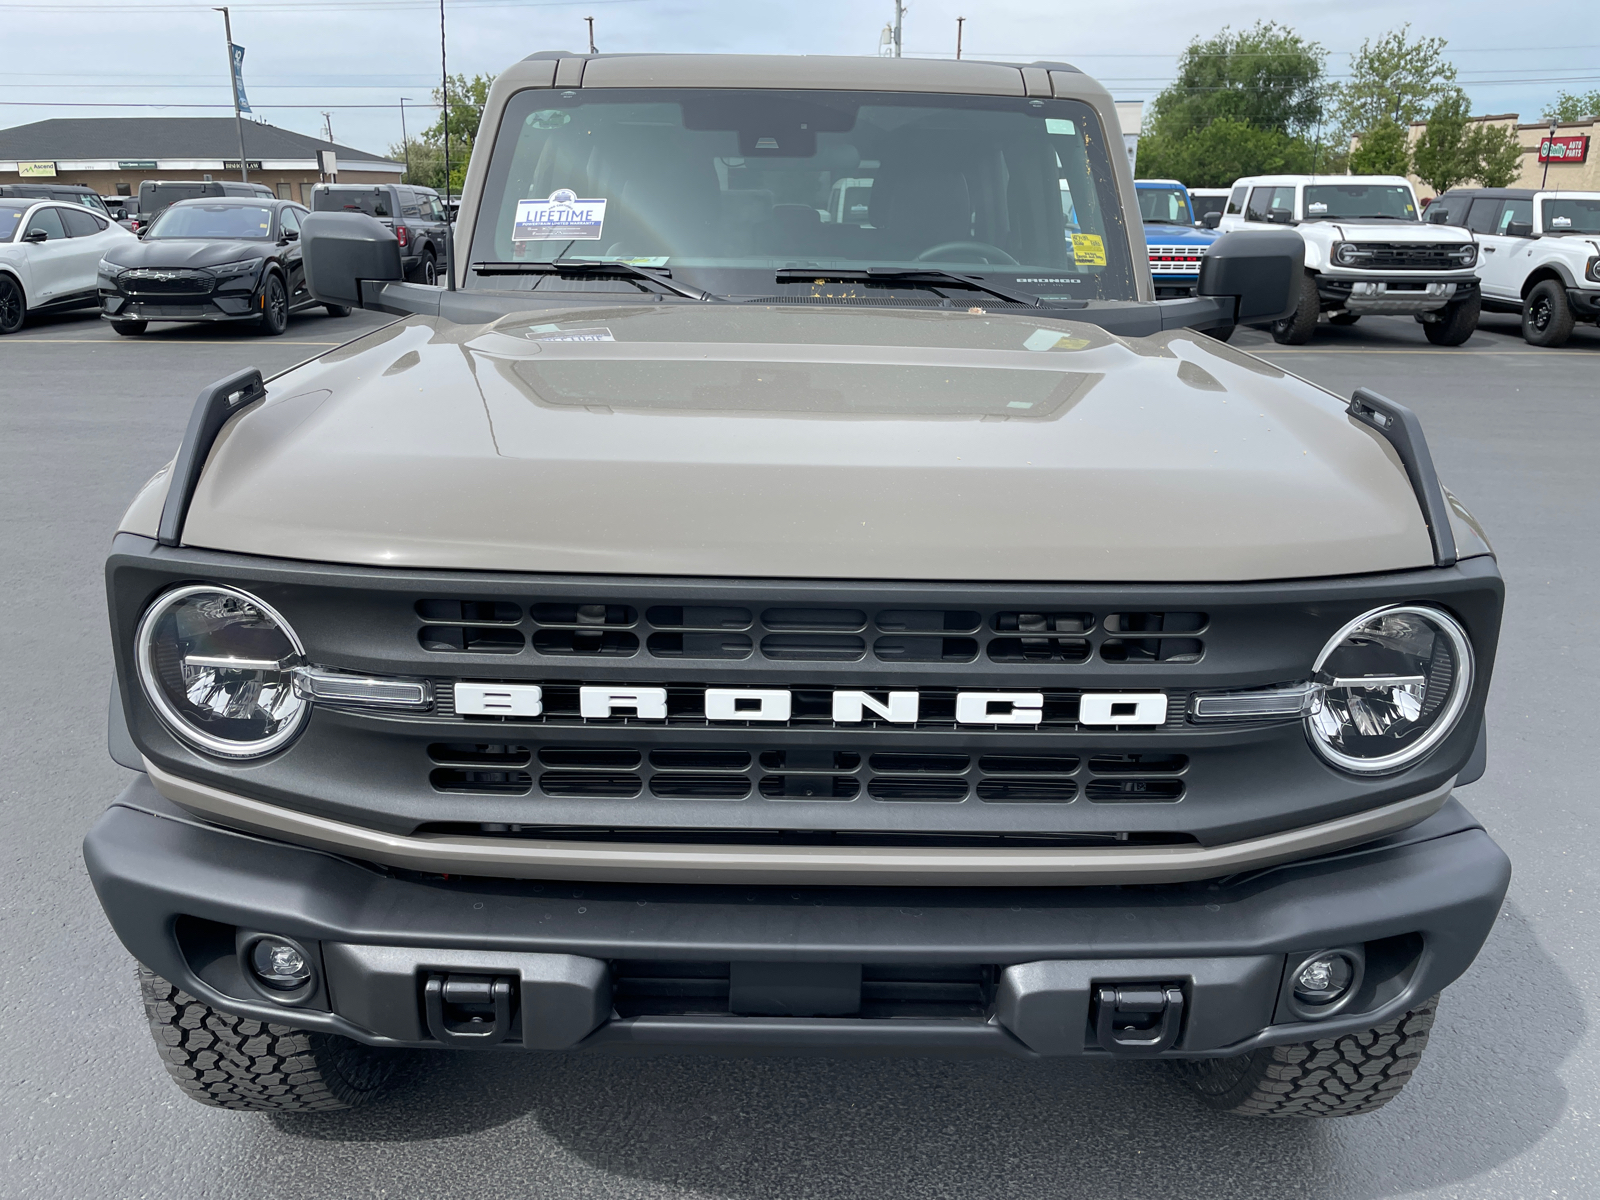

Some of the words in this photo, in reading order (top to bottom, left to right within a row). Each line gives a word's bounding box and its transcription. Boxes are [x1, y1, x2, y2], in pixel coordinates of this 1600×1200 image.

[1568, 141, 1582, 149] AUTO
[1566, 149, 1582, 157] PARTS
[526, 210, 594, 222] LIFETIME
[454, 681, 1168, 726] BRONCO
